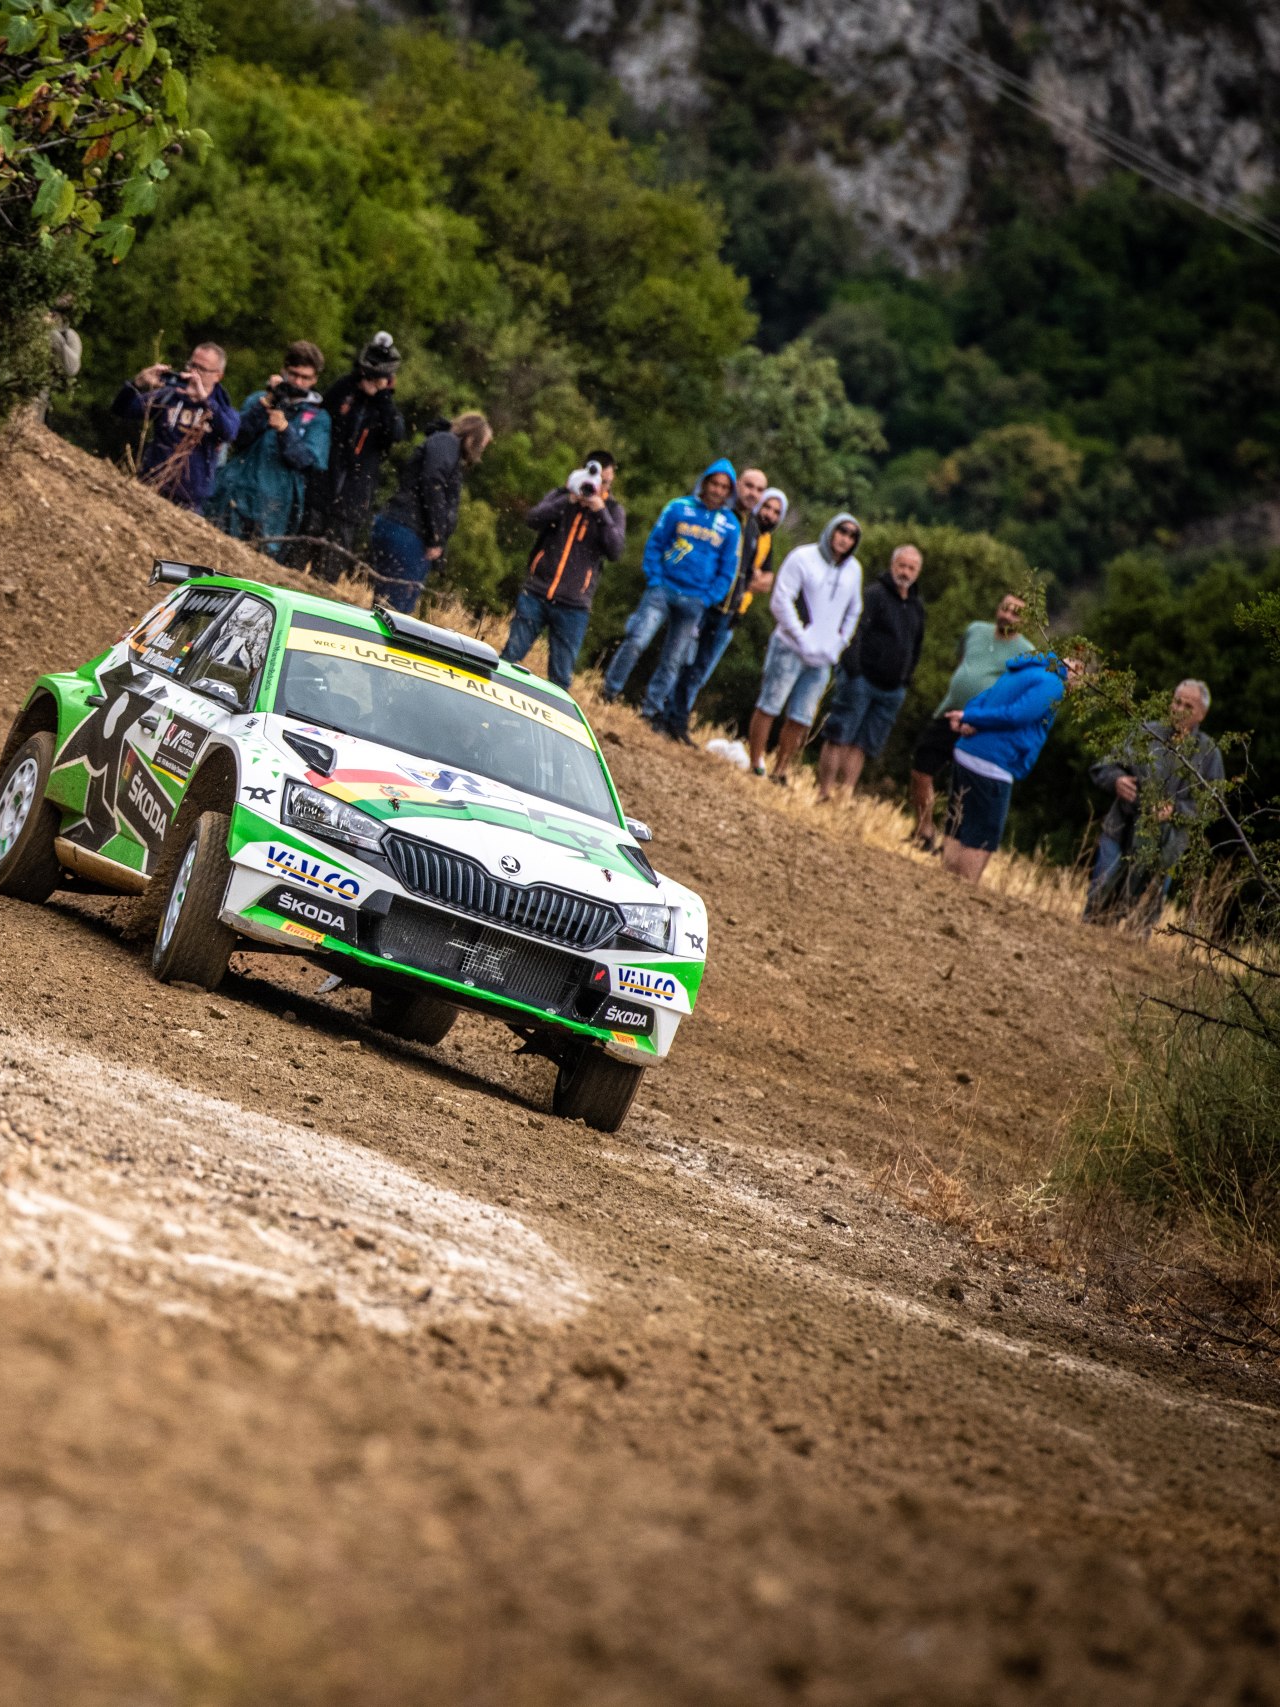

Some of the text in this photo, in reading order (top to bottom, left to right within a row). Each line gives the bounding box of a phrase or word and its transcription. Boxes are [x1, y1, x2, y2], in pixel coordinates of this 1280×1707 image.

[314, 639, 337, 648] WRC
[466, 679, 504, 702] ALL
[509, 695, 553, 722] LIVE
[128, 769, 167, 841] ŠKODA
[278, 891, 345, 931] ŠKODA
[605, 1005, 648, 1028] ŠKODA
